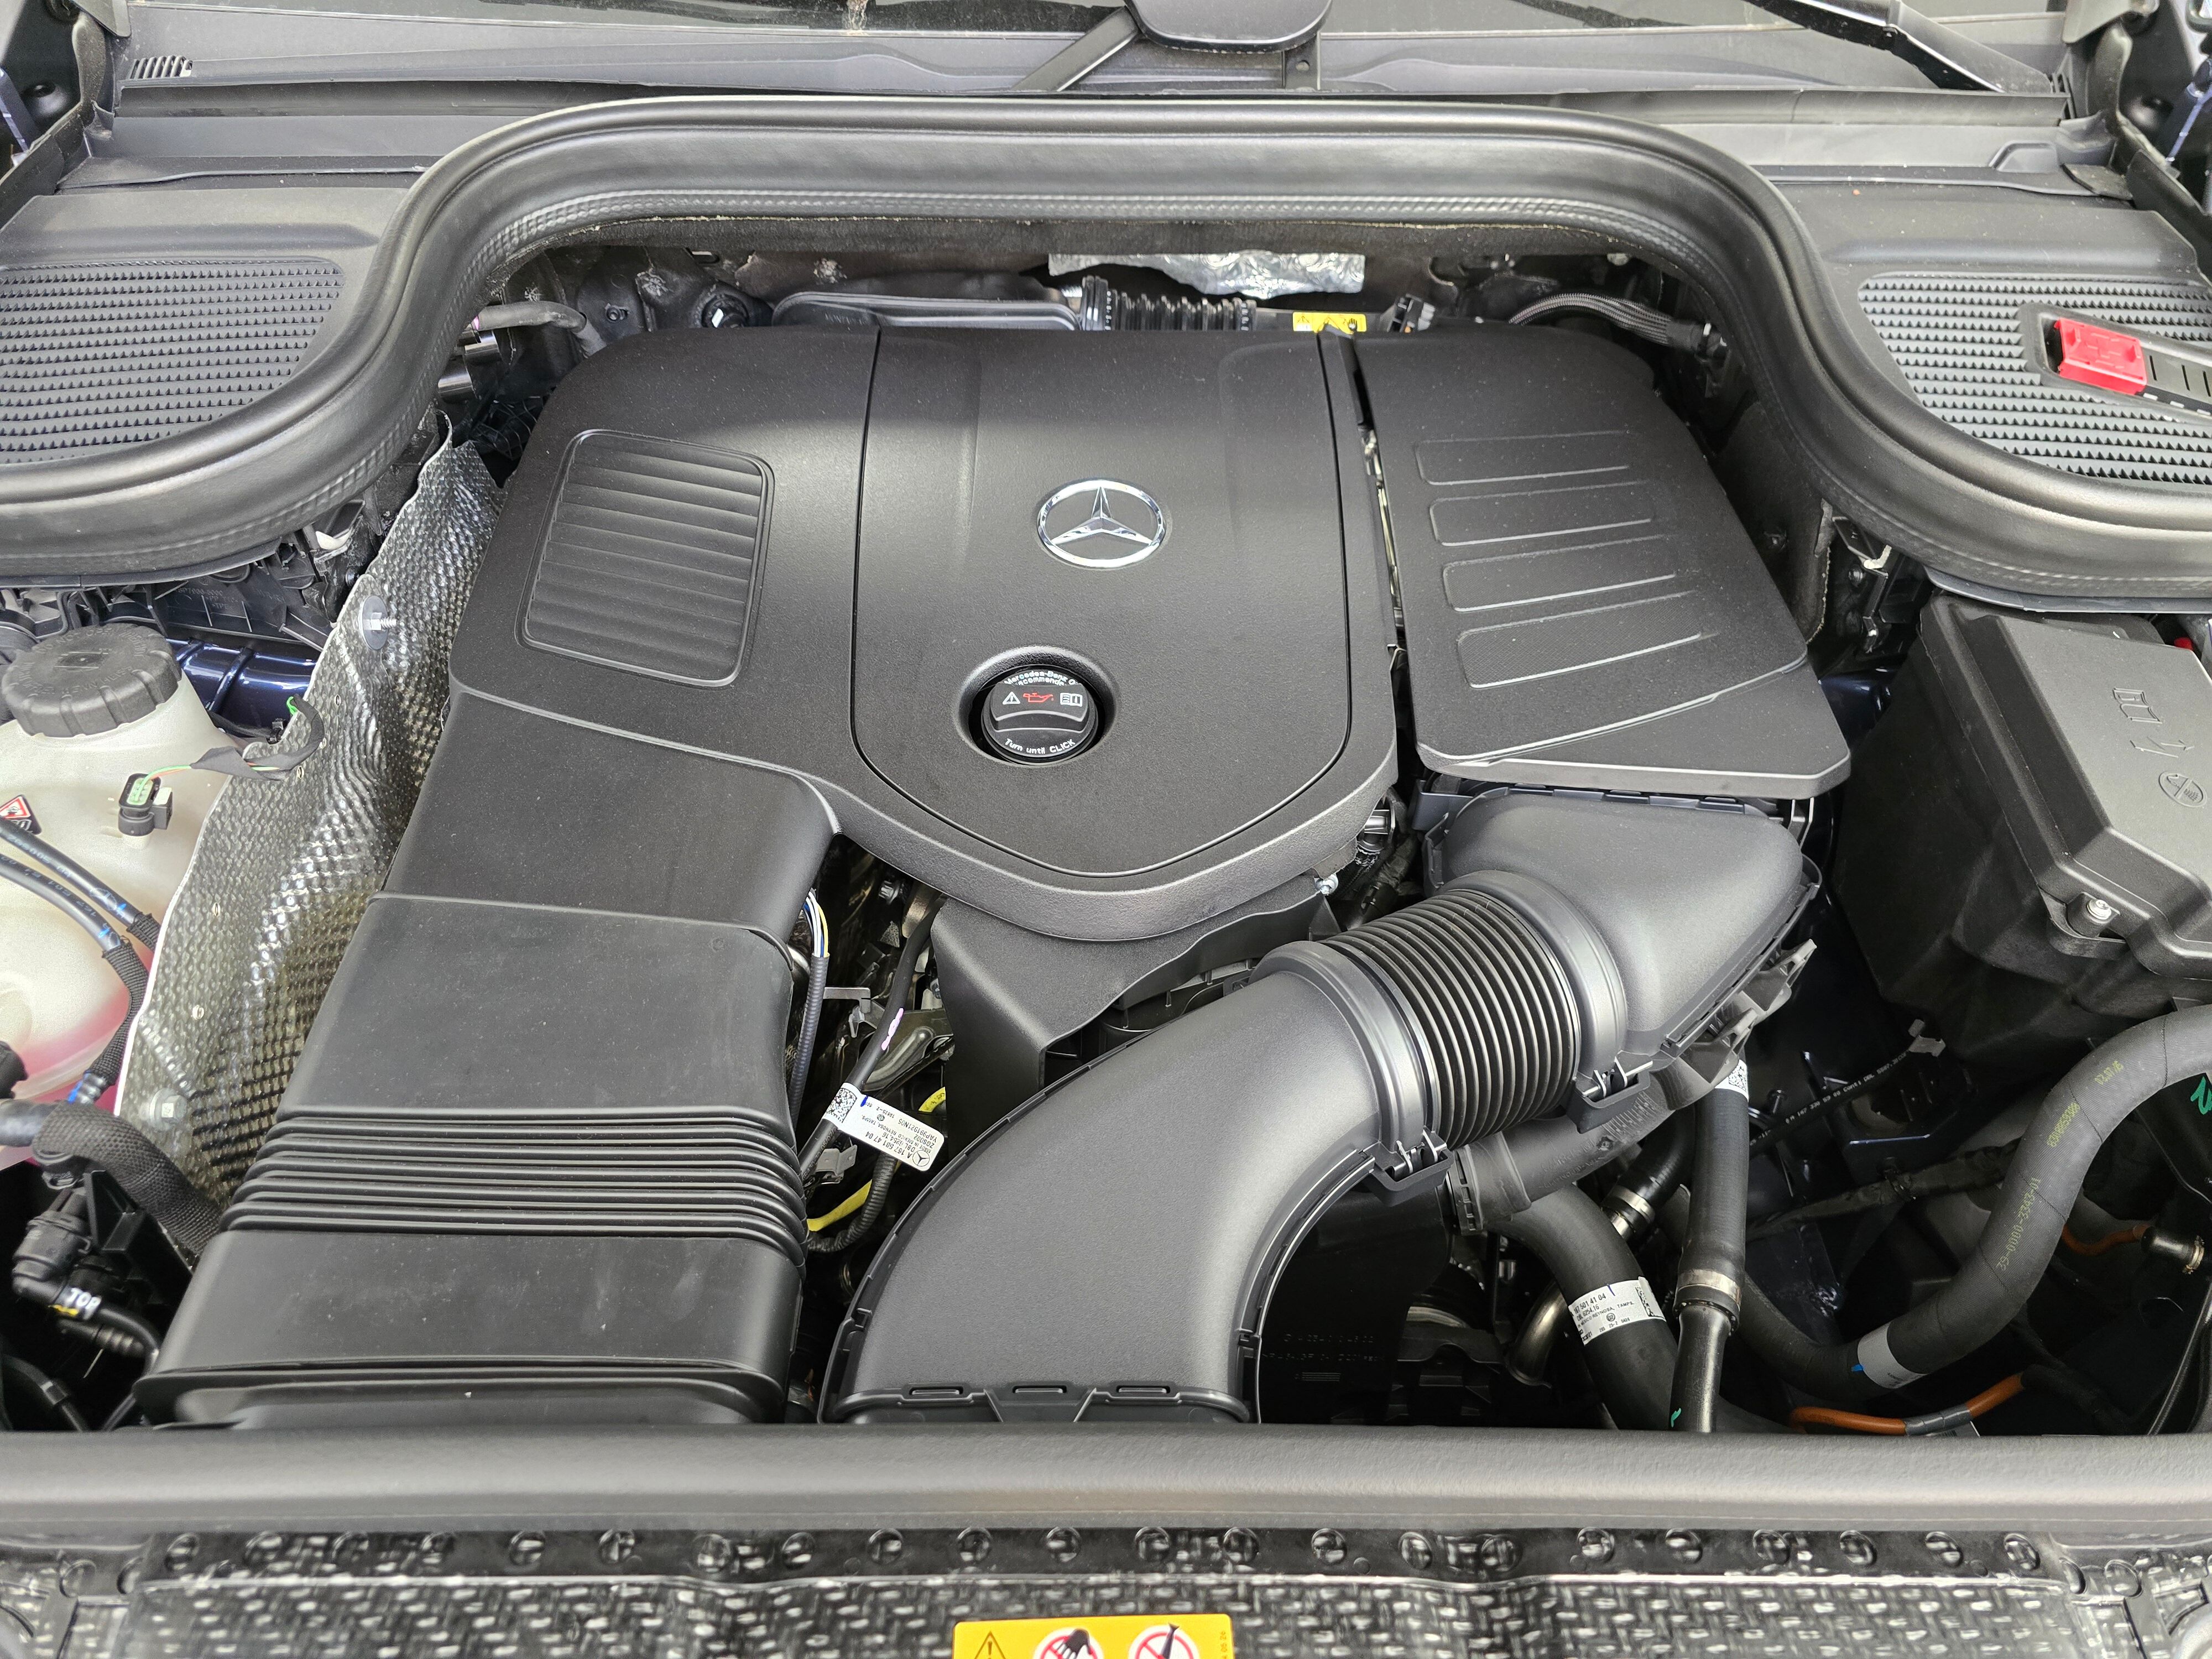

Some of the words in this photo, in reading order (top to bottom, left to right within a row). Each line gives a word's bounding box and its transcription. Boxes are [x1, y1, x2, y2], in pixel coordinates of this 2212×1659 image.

[1004, 670, 1068, 685] Mercedes-Benz
[1005, 738, 1023, 752] Turn
[1049, 739, 1076, 753] CLICK
[865, 1131, 873, 1139] 04
[873, 1135, 881, 1144] 47
[897, 1133, 914, 1144] MEXICO
[883, 1140, 894, 1150] 501
[894, 1145, 905, 1155] 167
[904, 1142, 915, 1152] DBL
[919, 1144, 931, 1153] MADE
[66, 1287, 102, 1310] TOP
[1598, 1292, 1606, 1301] 04
